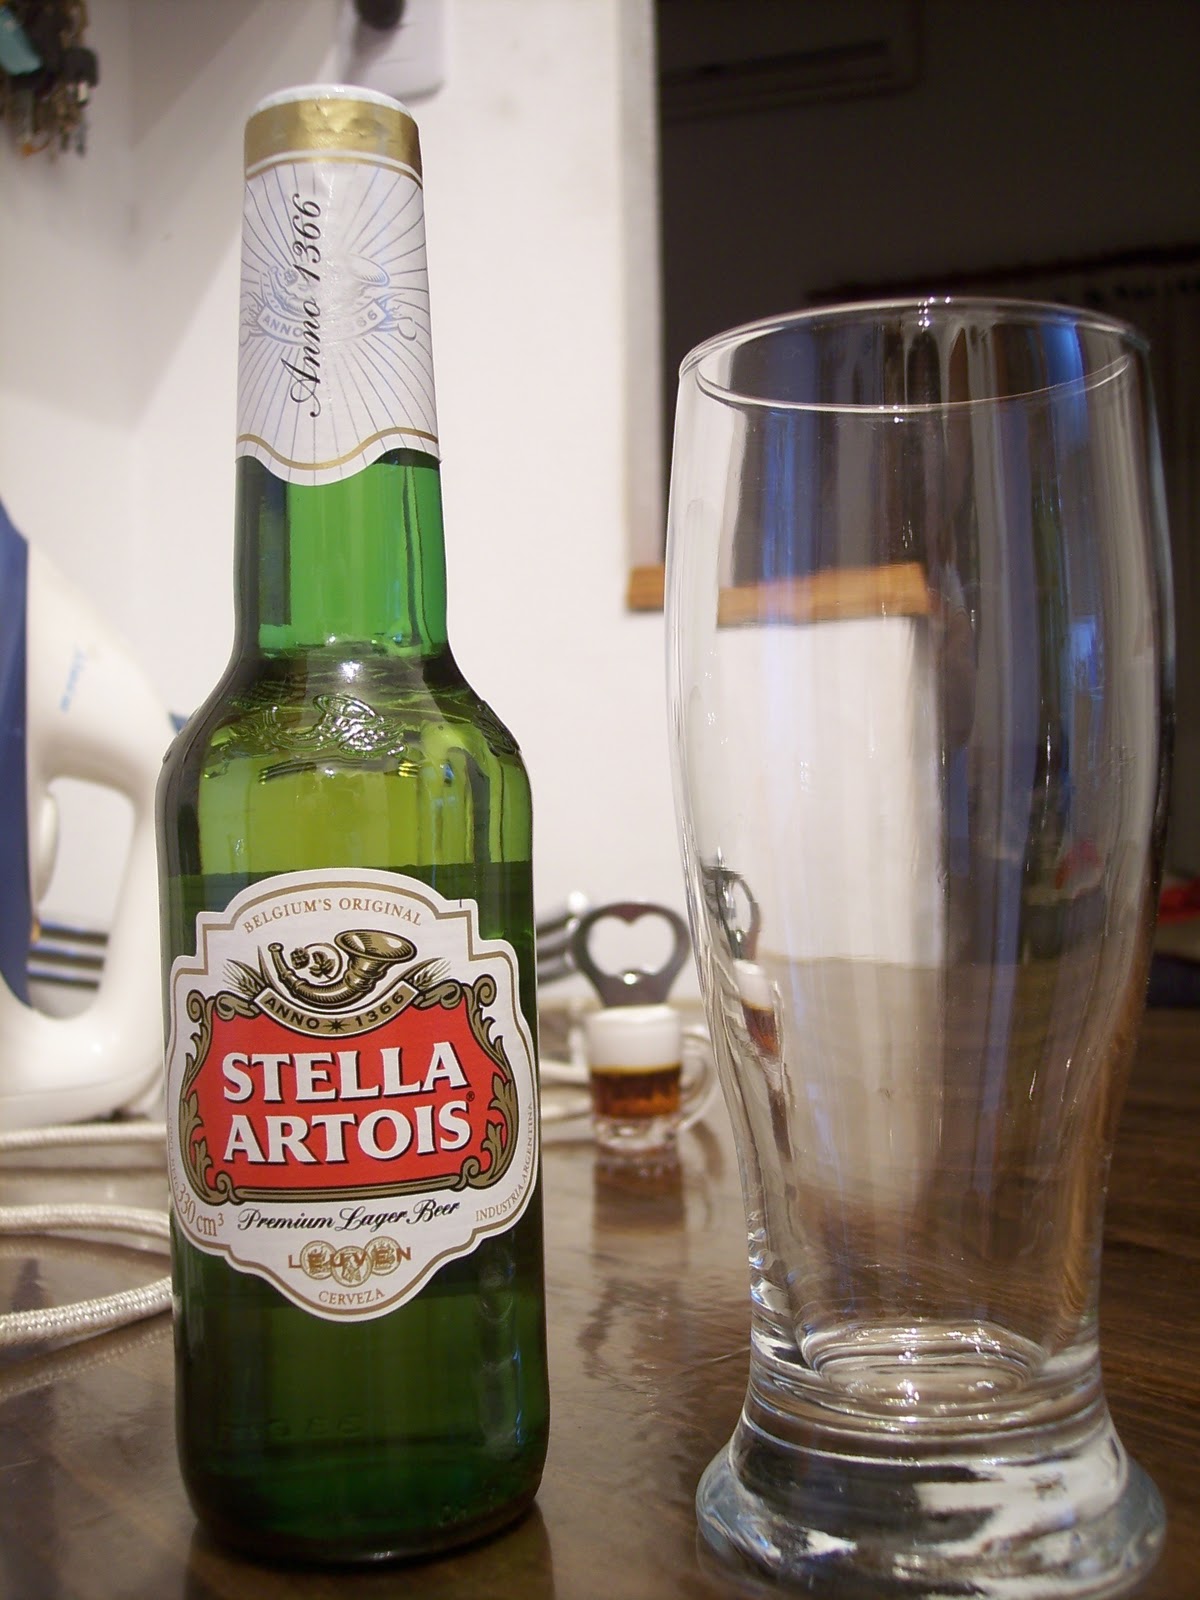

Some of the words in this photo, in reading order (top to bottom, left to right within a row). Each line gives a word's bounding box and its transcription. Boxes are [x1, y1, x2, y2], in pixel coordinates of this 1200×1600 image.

[292, 192, 322, 283] 1366
[280, 298, 322, 418] Anno
[242, 898, 332, 934] BELGIUM'S
[339, 898, 422, 926] ORIGINAL
[264, 998, 320, 1030] ANNO
[354, 993, 405, 1027] 1366
[222, 1041, 471, 1102] STELLA
[223, 1100, 472, 1163] ARTOIS
[475, 1184, 524, 1222] INDUSTRIA
[522, 1101, 534, 1183] ARGENTINA
[178, 1183, 196, 1225] 330
[237, 1208, 335, 1231] Premium
[334, 1205, 408, 1232] Lager
[406, 1198, 461, 1225] Beer
[288, 1246, 412, 1269] LEUVEN
[318, 1287, 386, 1306] CERVEZA
